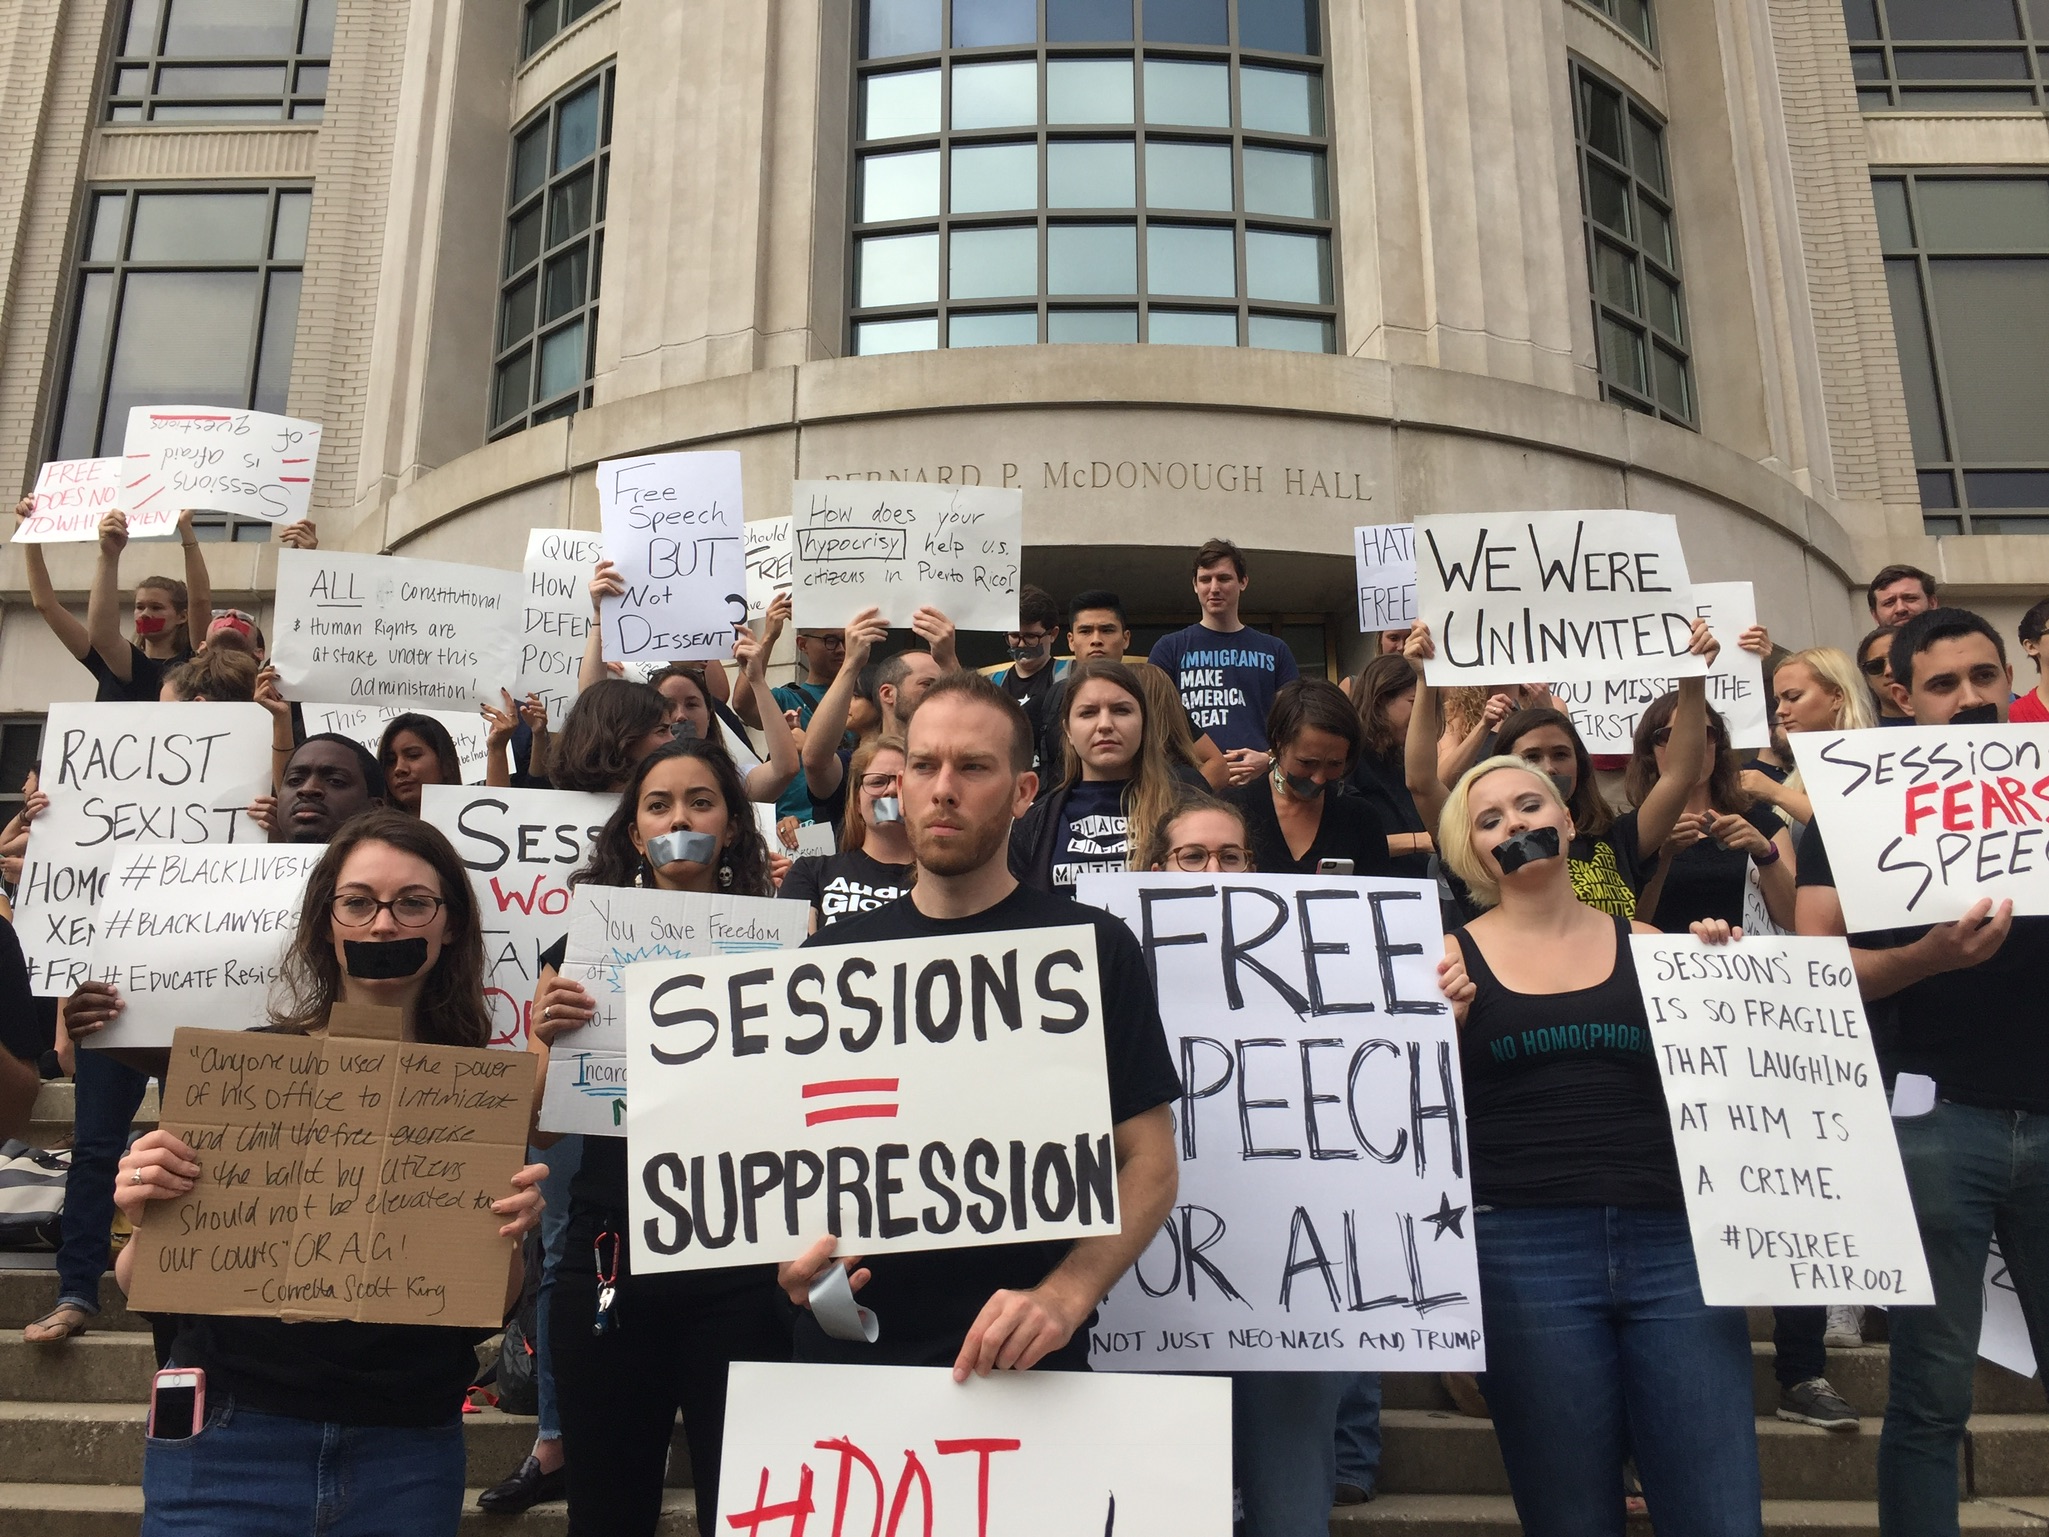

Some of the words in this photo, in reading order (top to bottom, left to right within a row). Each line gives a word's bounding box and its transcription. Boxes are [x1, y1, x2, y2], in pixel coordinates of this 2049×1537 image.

[44, 461, 106, 486] FREE
[160, 448, 225, 471] afraid
[244, 454, 260, 469] is
[34, 486, 84, 513] DOES
[89, 486, 116, 508] NO
[172, 470, 291, 518] Sessions
[615, 462, 678, 505] Free
[1002, 463, 1022, 489] P.
[1043, 461, 1264, 493] McDONOUGH
[1284, 467, 1374, 502] HALL
[56, 511, 110, 533] WHIT
[628, 501, 727, 533] Speech
[809, 494, 853, 528] How
[872, 501, 916, 525] does
[934, 509, 985, 538] your
[543, 535, 602, 563] QUES
[648, 536, 739, 579] BUT
[804, 530, 899, 563] hypocrisy
[924, 533, 965, 560] help
[1362, 527, 1416, 567] HAT
[1425, 527, 1521, 593] WE
[1528, 520, 1672, 593] WERE
[309, 569, 365, 600] ALL
[400, 581, 502, 611] Constitutional
[532, 572, 576, 599] HOW
[803, 567, 865, 587] citizens
[885, 569, 903, 583] in
[917, 561, 964, 583] Puerto
[973, 564, 1018, 594] Rico?
[620, 585, 673, 609] Not
[1361, 583, 1417, 628] FREE
[310, 618, 362, 636] Human
[374, 620, 418, 641] Rights
[428, 623, 457, 639] are
[1443, 607, 1694, 668] UNINVITED
[388, 649, 433, 665] under
[437, 648, 479, 666] this
[1180, 649, 1276, 673] IMMIGRANTS
[1180, 669, 1224, 690] MAKE
[1605, 677, 1680, 705] MISSE
[1706, 674, 1752, 702] THE
[1181, 687, 1247, 711] AMERICA
[1191, 708, 1229, 729] REAT
[1569, 710, 1639, 741] FIRST
[58, 729, 231, 791] RACIST
[75, 797, 249, 847] SEXIST
[1877, 829, 2049, 912] SPEE
[590, 899, 636, 943] You
[650, 915, 695, 941] Save
[1138, 883, 1449, 1022] FREE
[1807, 960, 1853, 988] EGO
[649, 948, 1091, 1066] SESSIONS
[1650, 996, 1688, 1024] IS
[1703, 999, 1736, 1024] SO
[1744, 998, 1860, 1039] FRAGILE
[1490, 1035, 1517, 1063] NO
[1661, 1044, 1728, 1077] THAT
[1747, 1046, 1868, 1088] LAUGHING
[289, 1052, 329, 1075] who
[340, 1053, 384, 1075] used
[400, 1052, 440, 1075] the
[454, 1061, 517, 1095] power
[222, 1085, 257, 1111] his
[265, 1086, 346, 1112] office
[358, 1086, 381, 1107] to
[1172, 1036, 1464, 1180] PEECH
[1679, 1102, 1708, 1132] AT
[1727, 1104, 1792, 1140] HIM
[1812, 1110, 1850, 1142] IS
[213, 1161, 251, 1188] the
[337, 1162, 365, 1200] by
[642, 1133, 1116, 1256] SUPPRESSION
[1697, 1164, 1714, 1195] A
[1739, 1165, 1842, 1201] CRIME.
[269, 1197, 313, 1223] not
[329, 1194, 358, 1218] be
[365, 1190, 465, 1220] elevated
[159, 1244, 204, 1271] our
[295, 1232, 331, 1265] OR
[1134, 1203, 1254, 1311] OR
[1720, 1224, 1860, 1260] #DESIREE
[345, 1276, 399, 1299] Scott
[407, 1276, 446, 1316] King
[1790, 1262, 1908, 1294] FAIROOZ
[1092, 1331, 1146, 1355] NOT
[1157, 1330, 1214, 1353] JUST
[1229, 1328, 1344, 1353] NEO-NAZIS
[1359, 1331, 1406, 1352] AND
[1412, 1328, 1483, 1353] TRUMP
